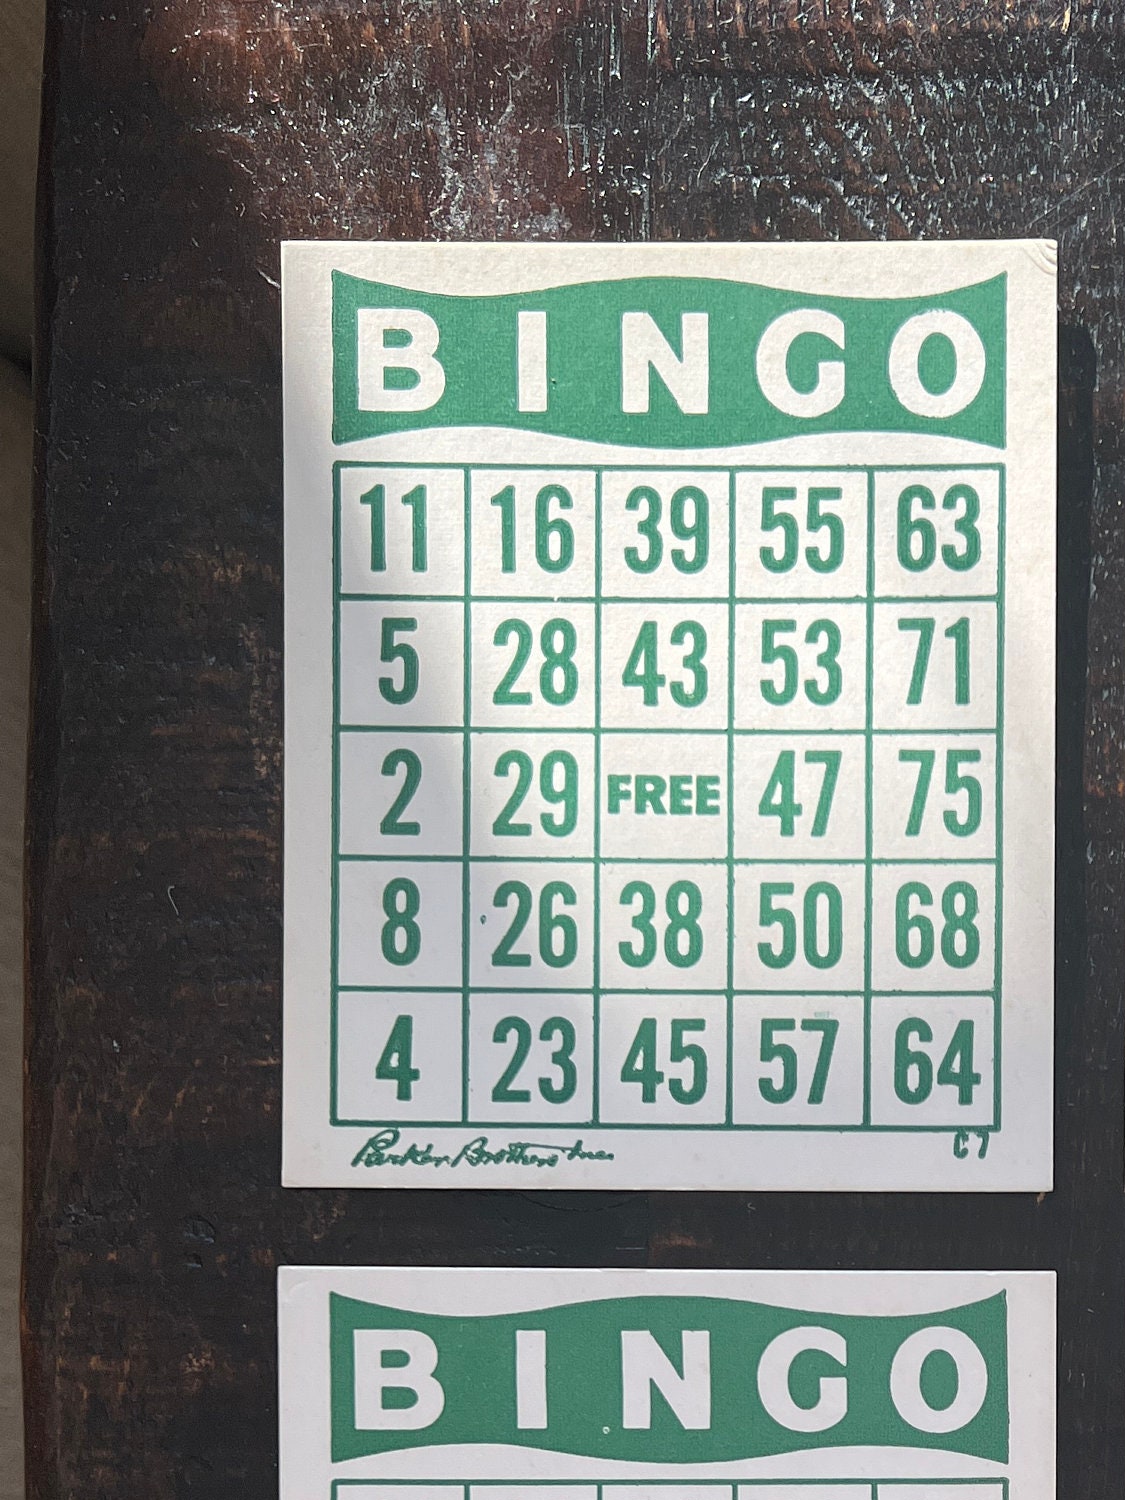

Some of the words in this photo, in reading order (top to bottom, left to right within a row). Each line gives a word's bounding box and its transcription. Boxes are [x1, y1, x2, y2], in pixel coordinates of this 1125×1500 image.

[356, 306, 987, 420] BINGO
[360, 484, 427, 573] 11
[490, 484, 574, 573] 16
[624, 486, 709, 574] 39
[760, 487, 844, 574] 55
[897, 484, 981, 573] 63
[379, 618, 419, 705] 5
[493, 618, 579, 706] 28
[622, 620, 708, 708] 43
[760, 619, 842, 706] 53
[898, 618, 970, 705] 71
[380, 749, 422, 836] 2
[492, 750, 579, 838] 29
[607, 774, 720, 816] FREE
[758, 750, 842, 837] 47
[899, 749, 982, 837] 75
[381, 878, 421, 966] 8
[491, 881, 578, 968] 26
[618, 880, 703, 968] 38
[757, 881, 843, 970] 50
[895, 881, 980, 969] 68
[375, 1015, 420, 1101] 4
[491, 1016, 577, 1104] 23
[620, 1018, 708, 1105] 45
[758, 1018, 839, 1105] 57
[894, 1017, 981, 1105] 64
[350, 1129, 451, 1168] Parker
[450, 1136, 559, 1168] Brothers
[352, 1325, 989, 1435] BINGO
